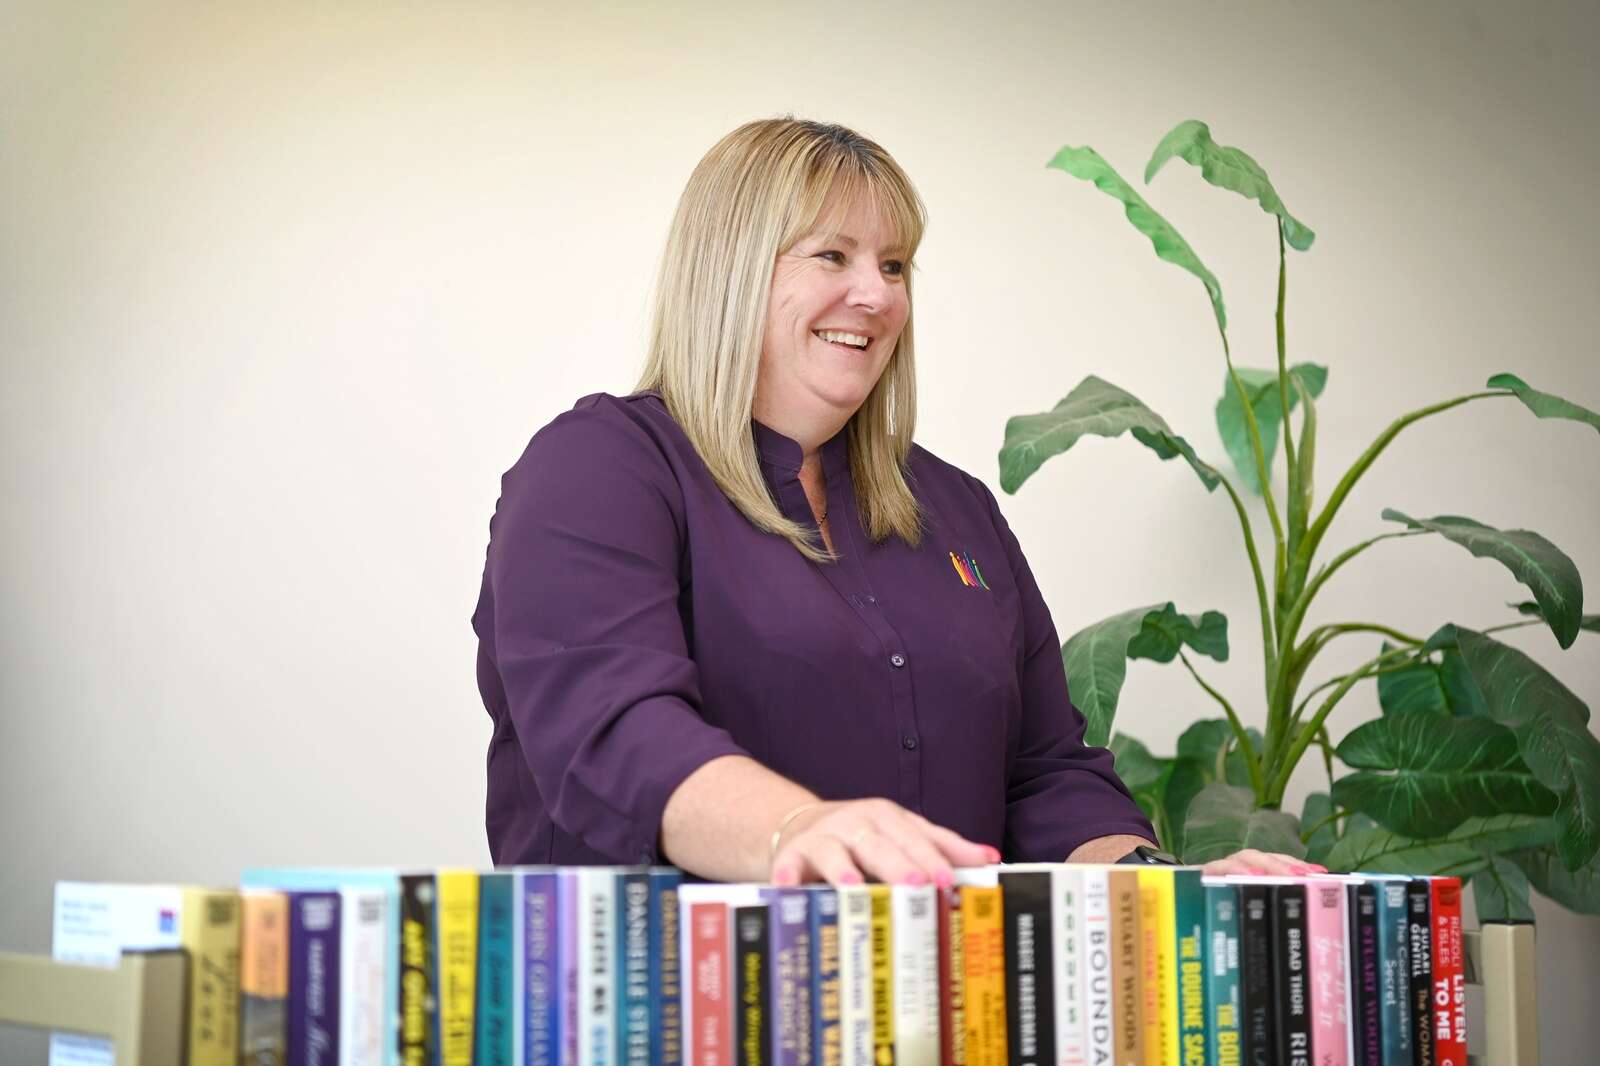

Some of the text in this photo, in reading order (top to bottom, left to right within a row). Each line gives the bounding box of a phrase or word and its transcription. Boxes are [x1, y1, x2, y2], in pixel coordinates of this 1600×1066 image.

[1438, 915, 1448, 926] &
[1450, 916, 1460, 967] RIZZOLI
[1121, 891, 1136, 1051] STUART WOODS
[1287, 928, 1303, 1016] BRAD THOR
[1361, 925, 1376, 992] STUART
[1411, 924, 1422, 977] GENTILL
[1421, 927, 1429, 974] SULARI
[1182, 961, 1201, 1029] BOURNE
[1385, 959, 1397, 1006] Secret
[1398, 917, 1410, 1050] The Codebreaker's
[1418, 989, 1427, 1009] The
[1435, 977, 1451, 1040] TO ME
[1453, 974, 1466, 1043] LISTEN
[1253, 1006, 1265, 1041] THE
